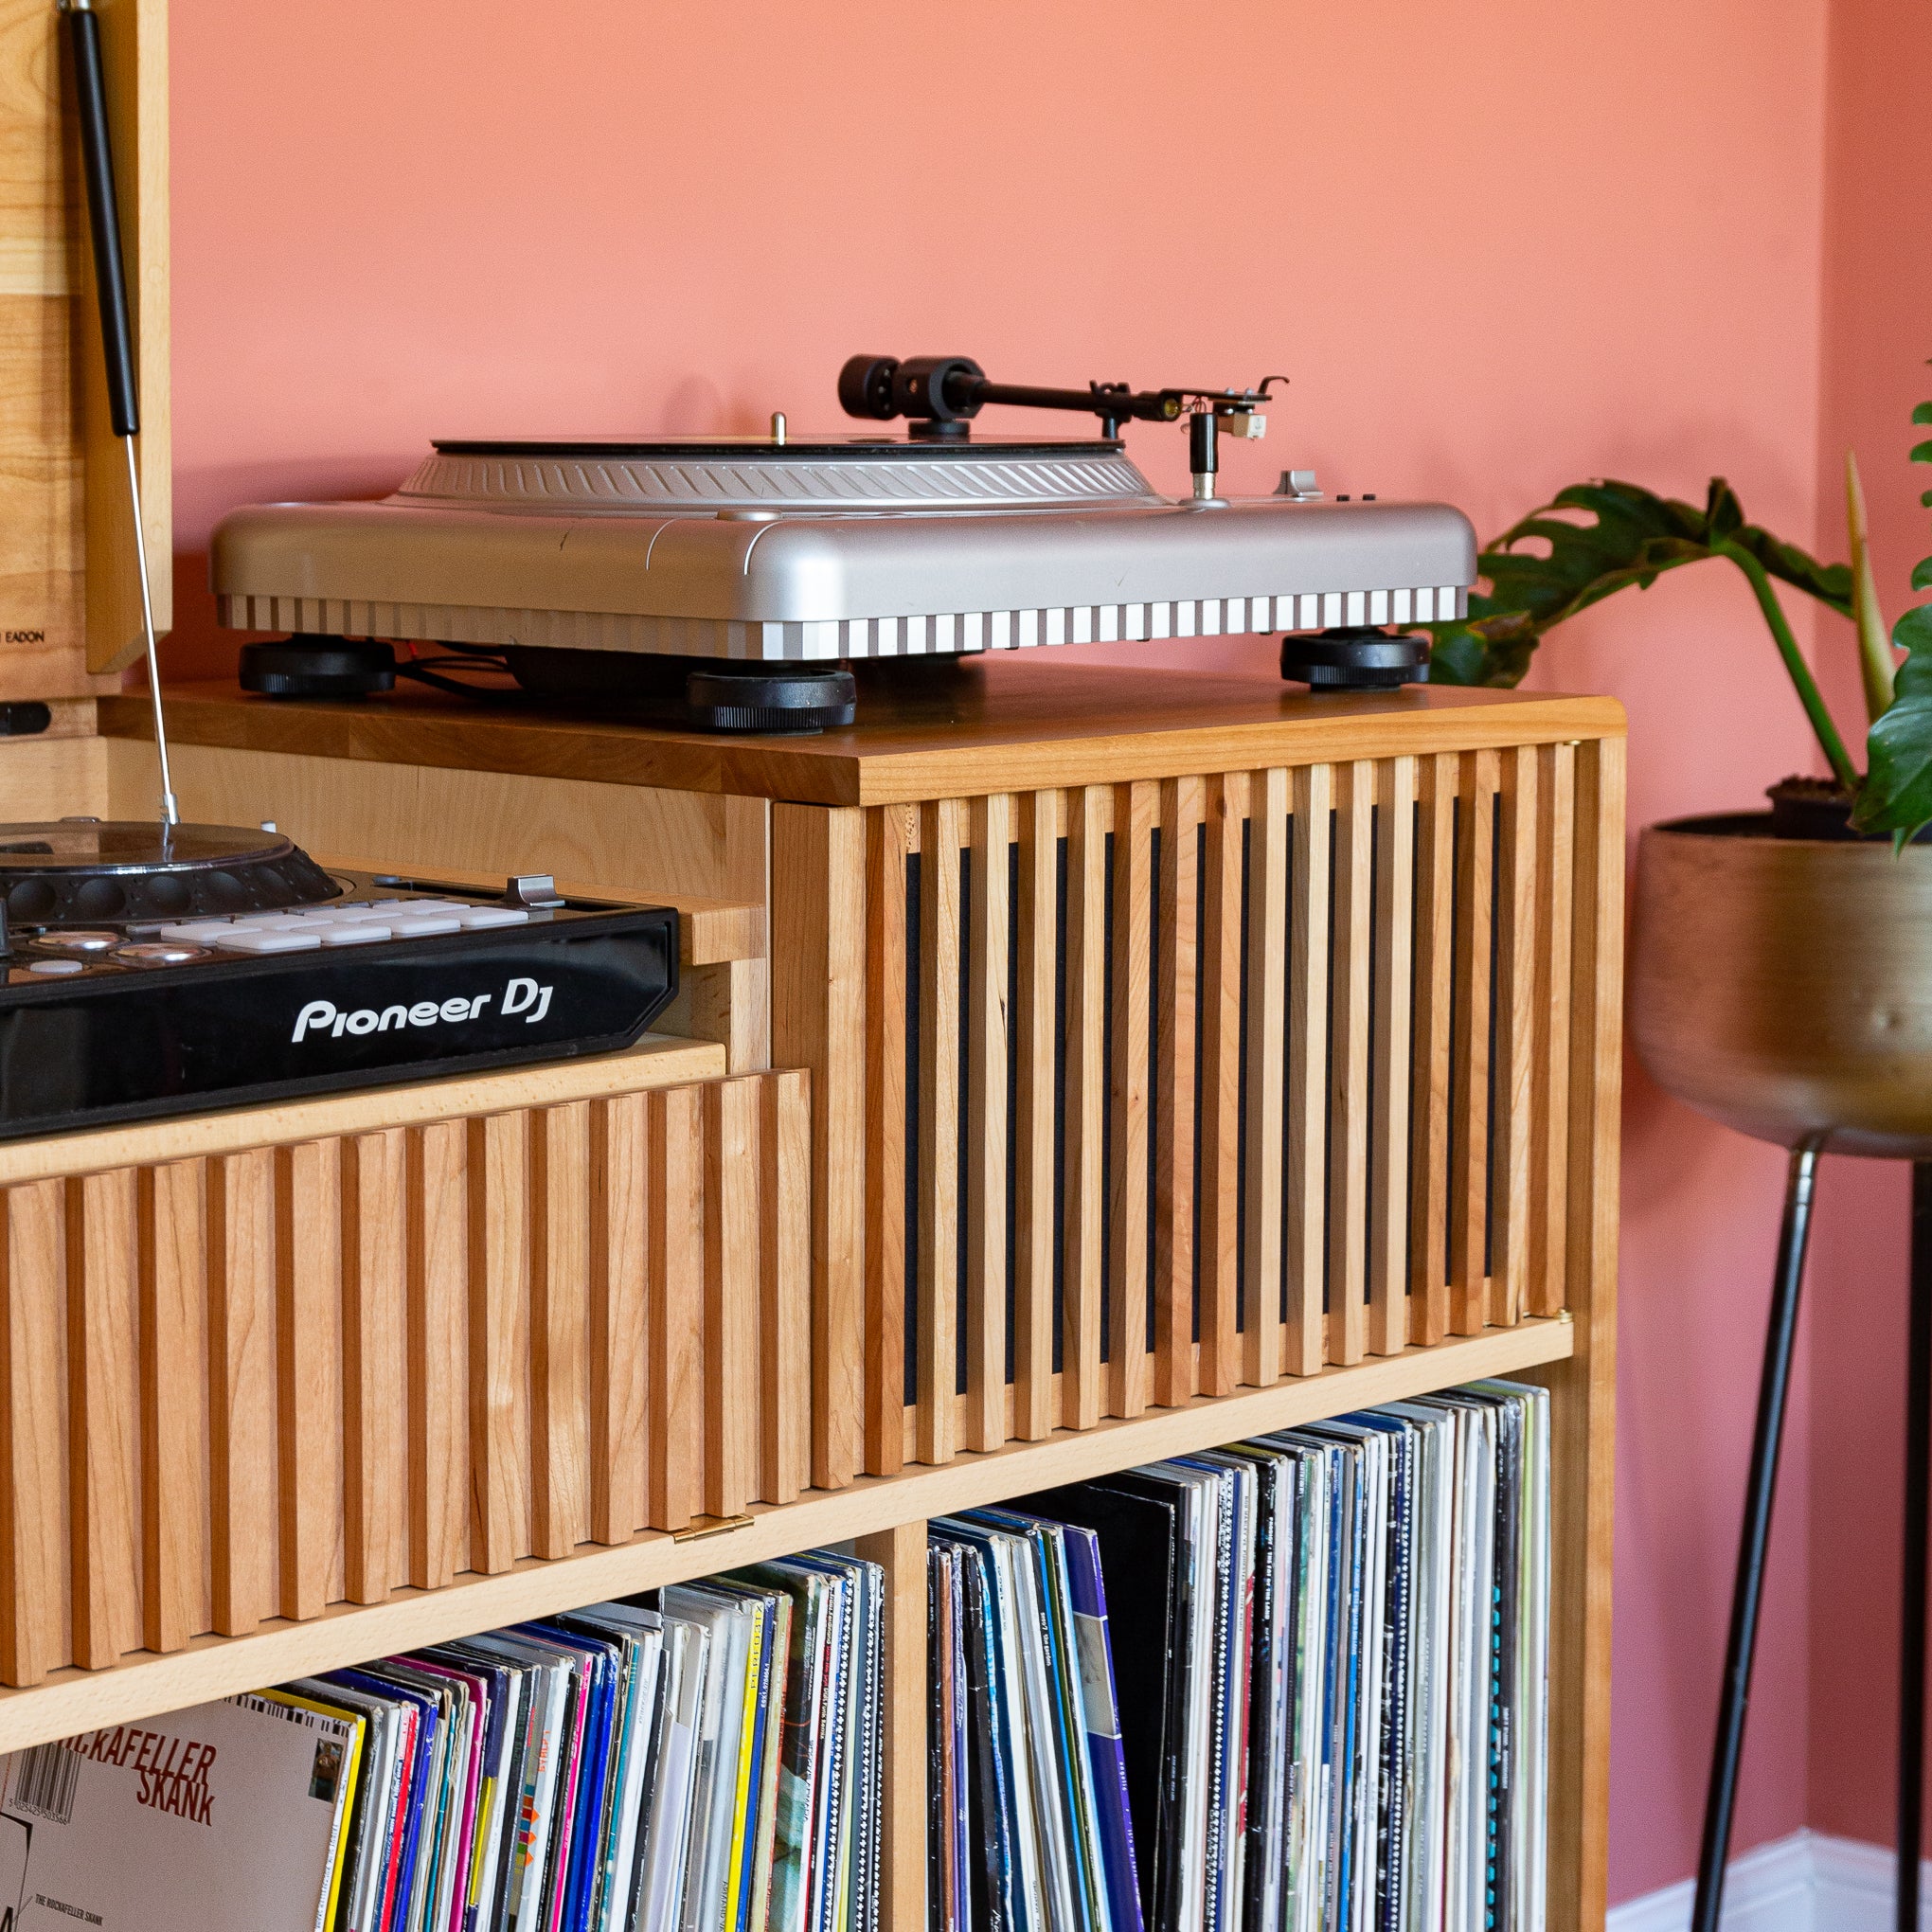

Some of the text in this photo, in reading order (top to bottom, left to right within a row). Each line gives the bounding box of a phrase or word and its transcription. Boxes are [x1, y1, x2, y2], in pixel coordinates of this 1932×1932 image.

[5, 630, 45, 644] EADON
[291, 976, 554, 1044] Pioneer DJ
[35, 1893, 47, 1907] THE
[45, 1896, 85, 1921] ROCKAFELLER
